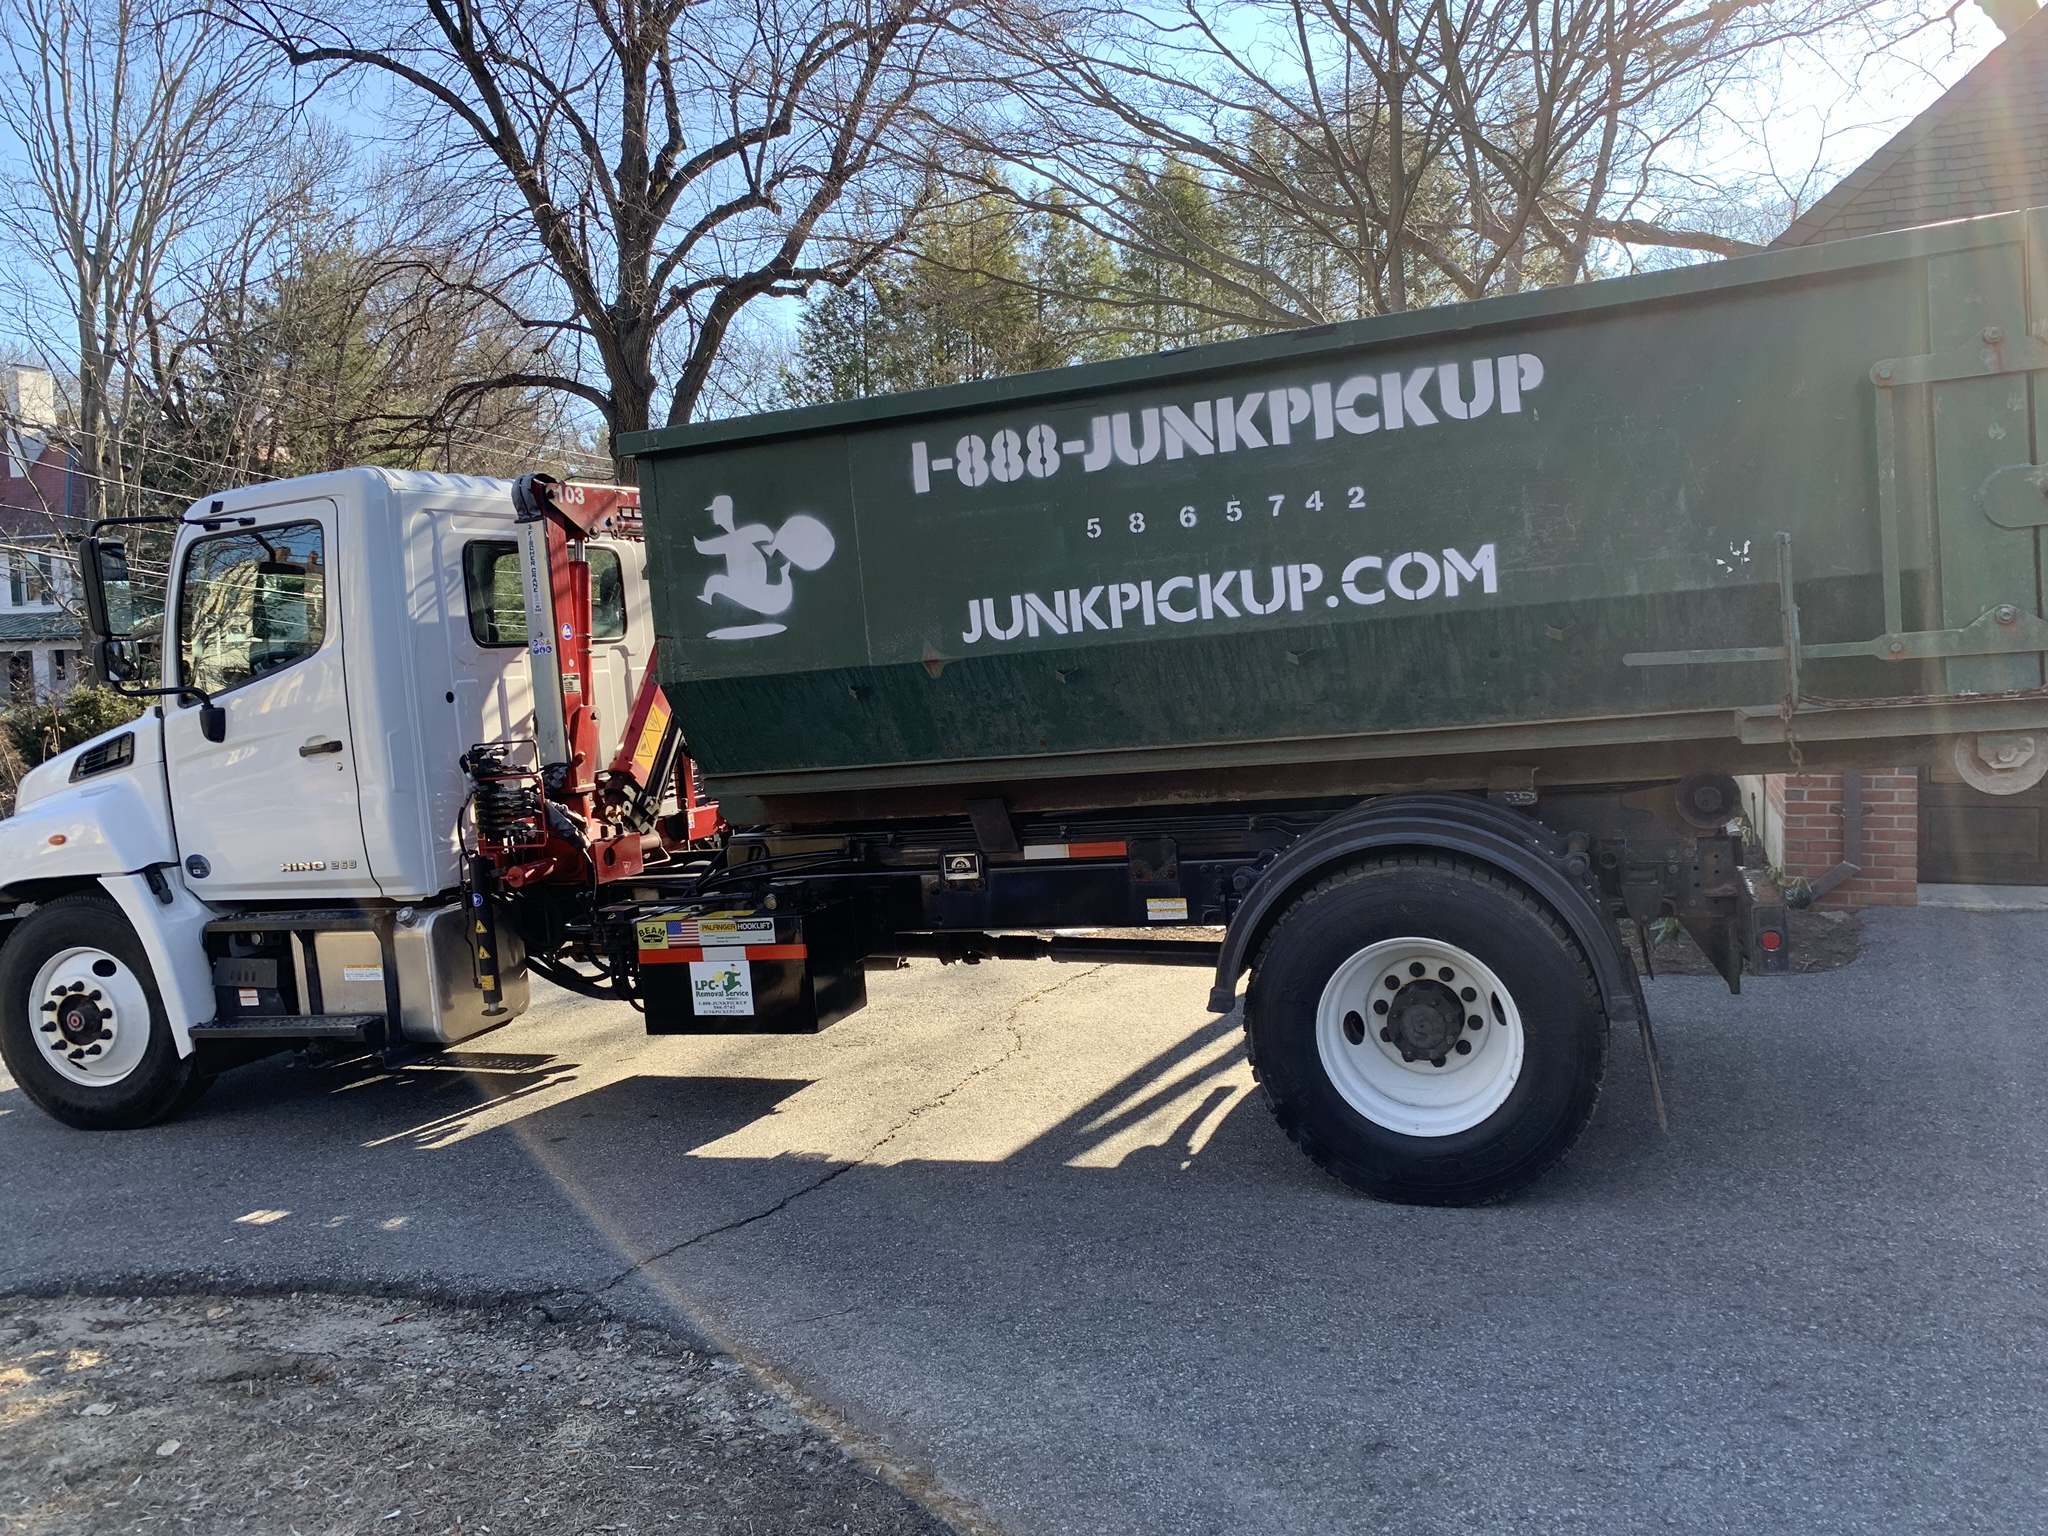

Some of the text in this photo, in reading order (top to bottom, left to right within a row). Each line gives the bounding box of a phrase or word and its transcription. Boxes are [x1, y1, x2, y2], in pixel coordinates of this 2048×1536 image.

[557, 485, 585, 505] 103
[962, 543, 1498, 644] JUNKPICKUP.COM
[280, 860, 357, 873] HINO 268
[638, 927, 666, 937] BEAM
[701, 922, 771, 931] PALFINGER HOOKLIFT
